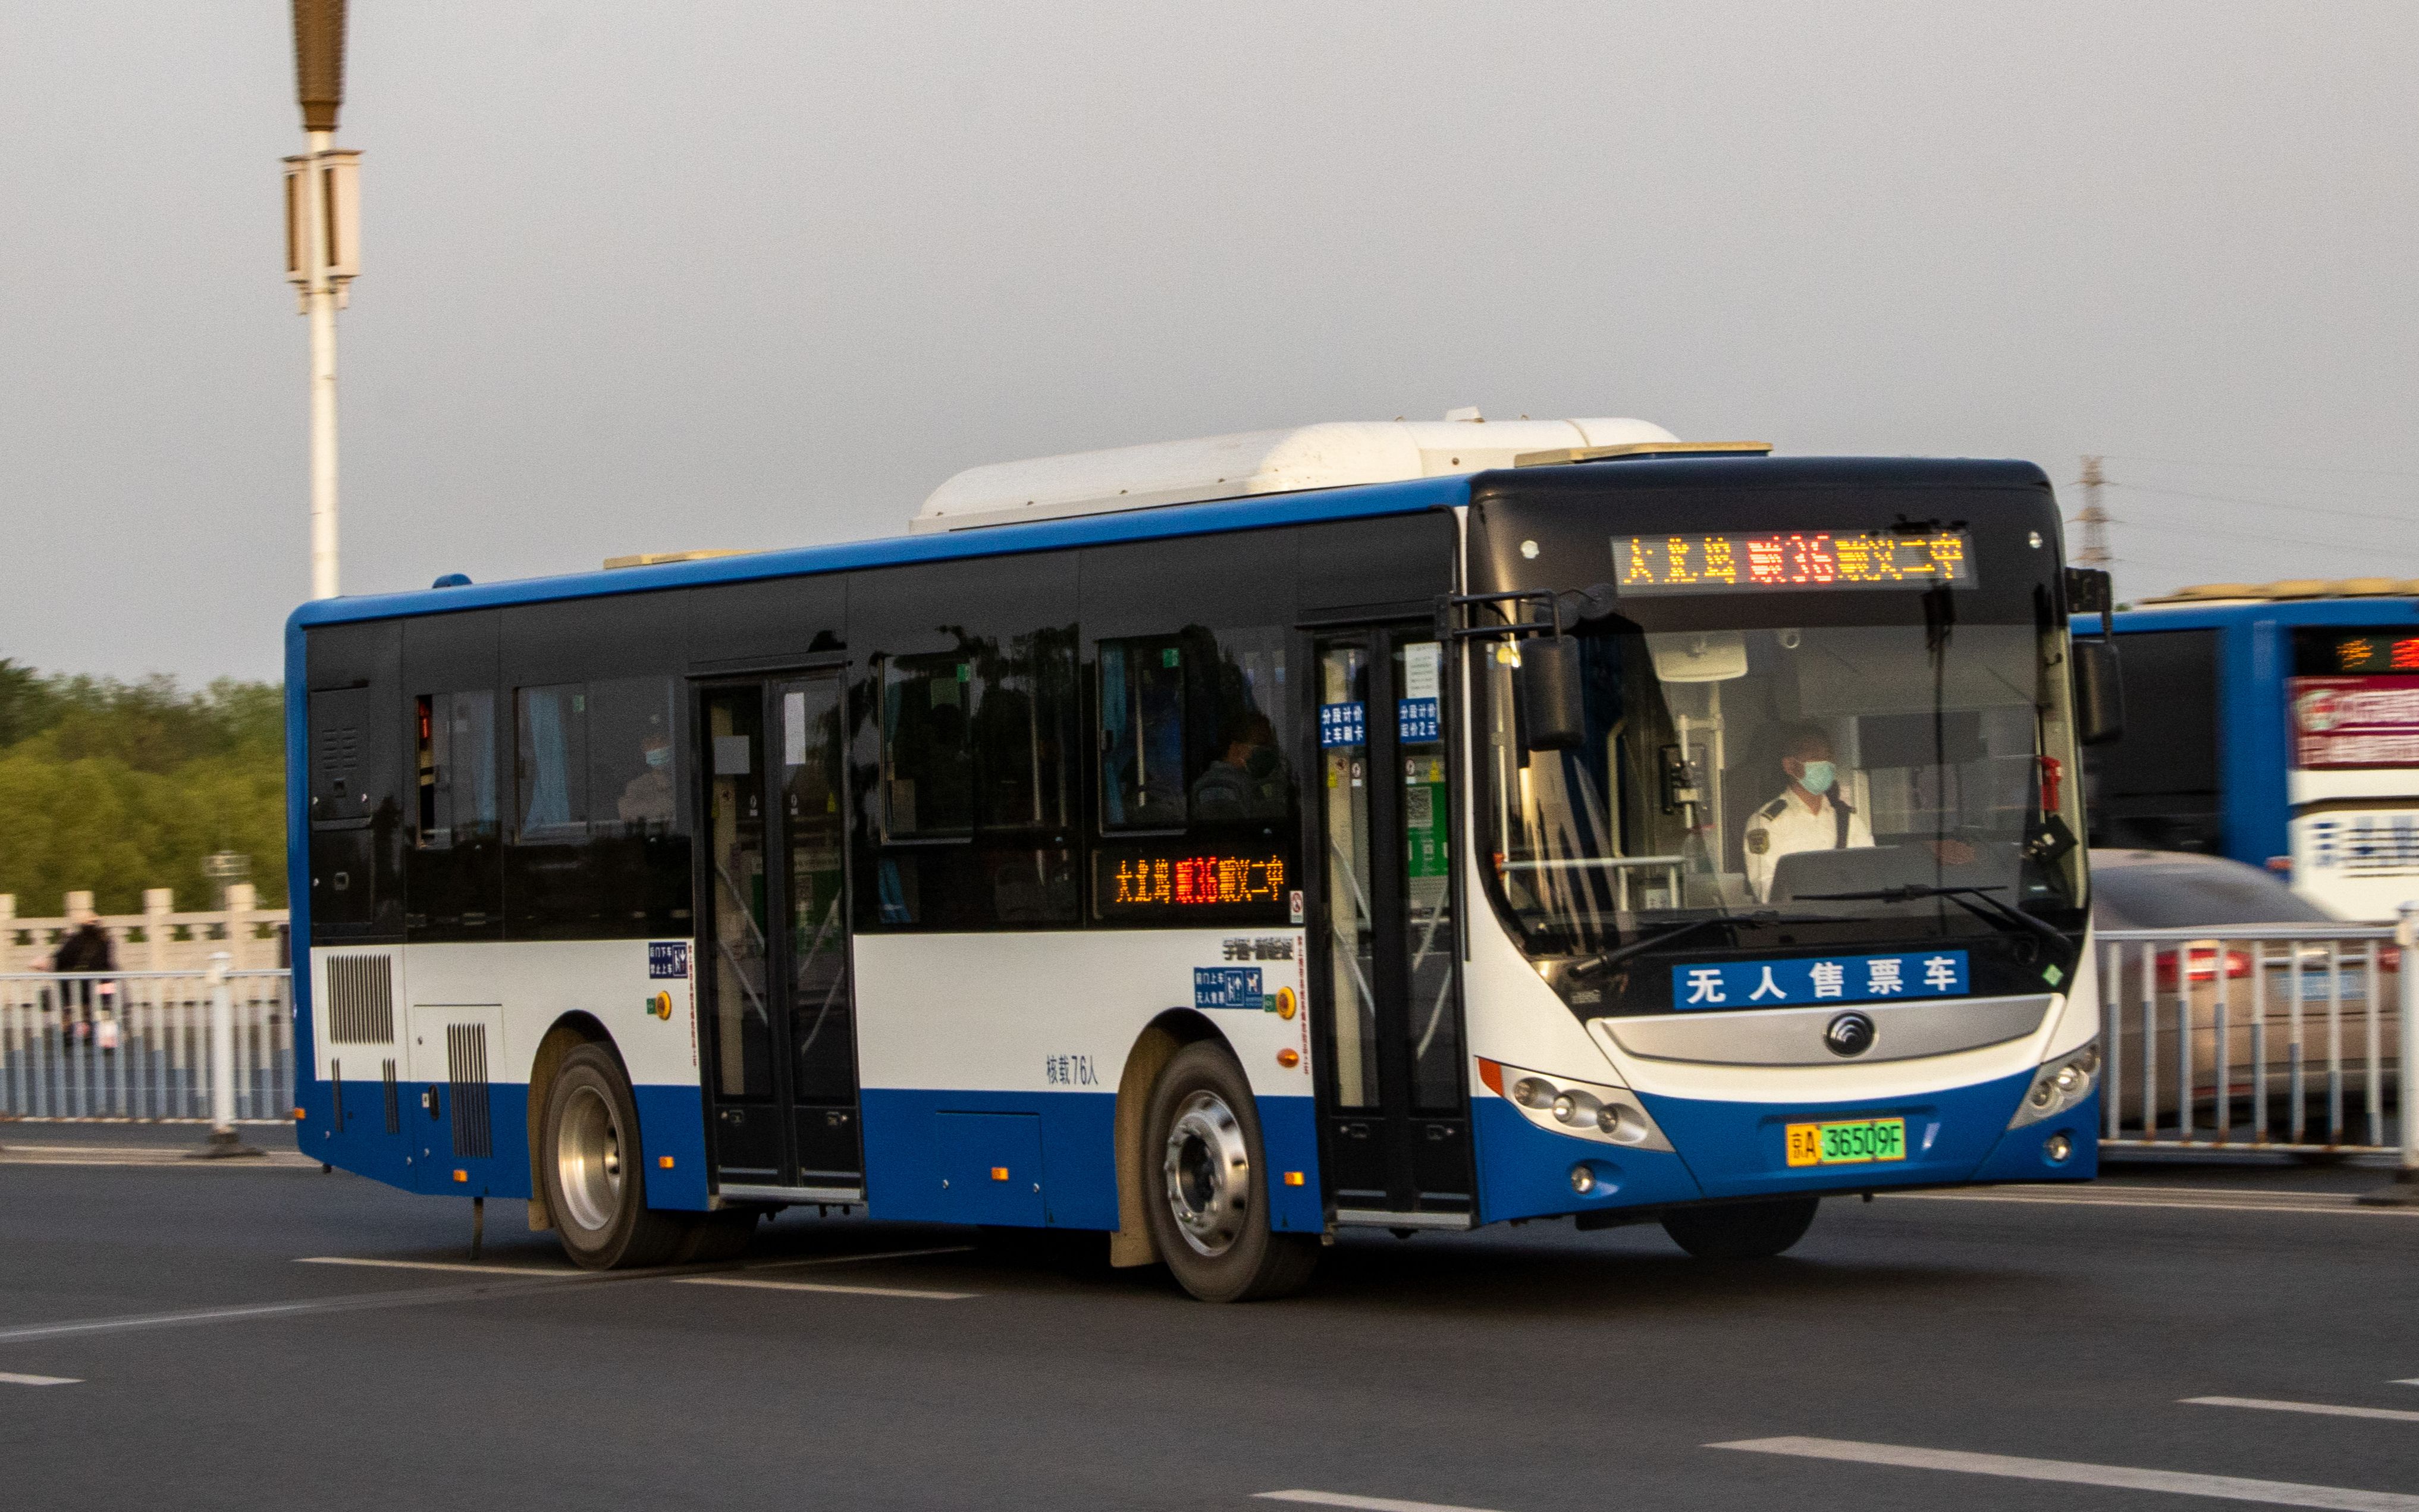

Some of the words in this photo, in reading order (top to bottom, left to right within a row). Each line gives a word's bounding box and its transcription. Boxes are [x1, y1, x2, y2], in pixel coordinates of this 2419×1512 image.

[1322, 705, 1363, 725] 分段计价
[1322, 724, 1363, 744] 上车刷卡
[1687, 956, 1958, 1004] 无人售票车
[1047, 1055, 1099, 1085] 核载76人
